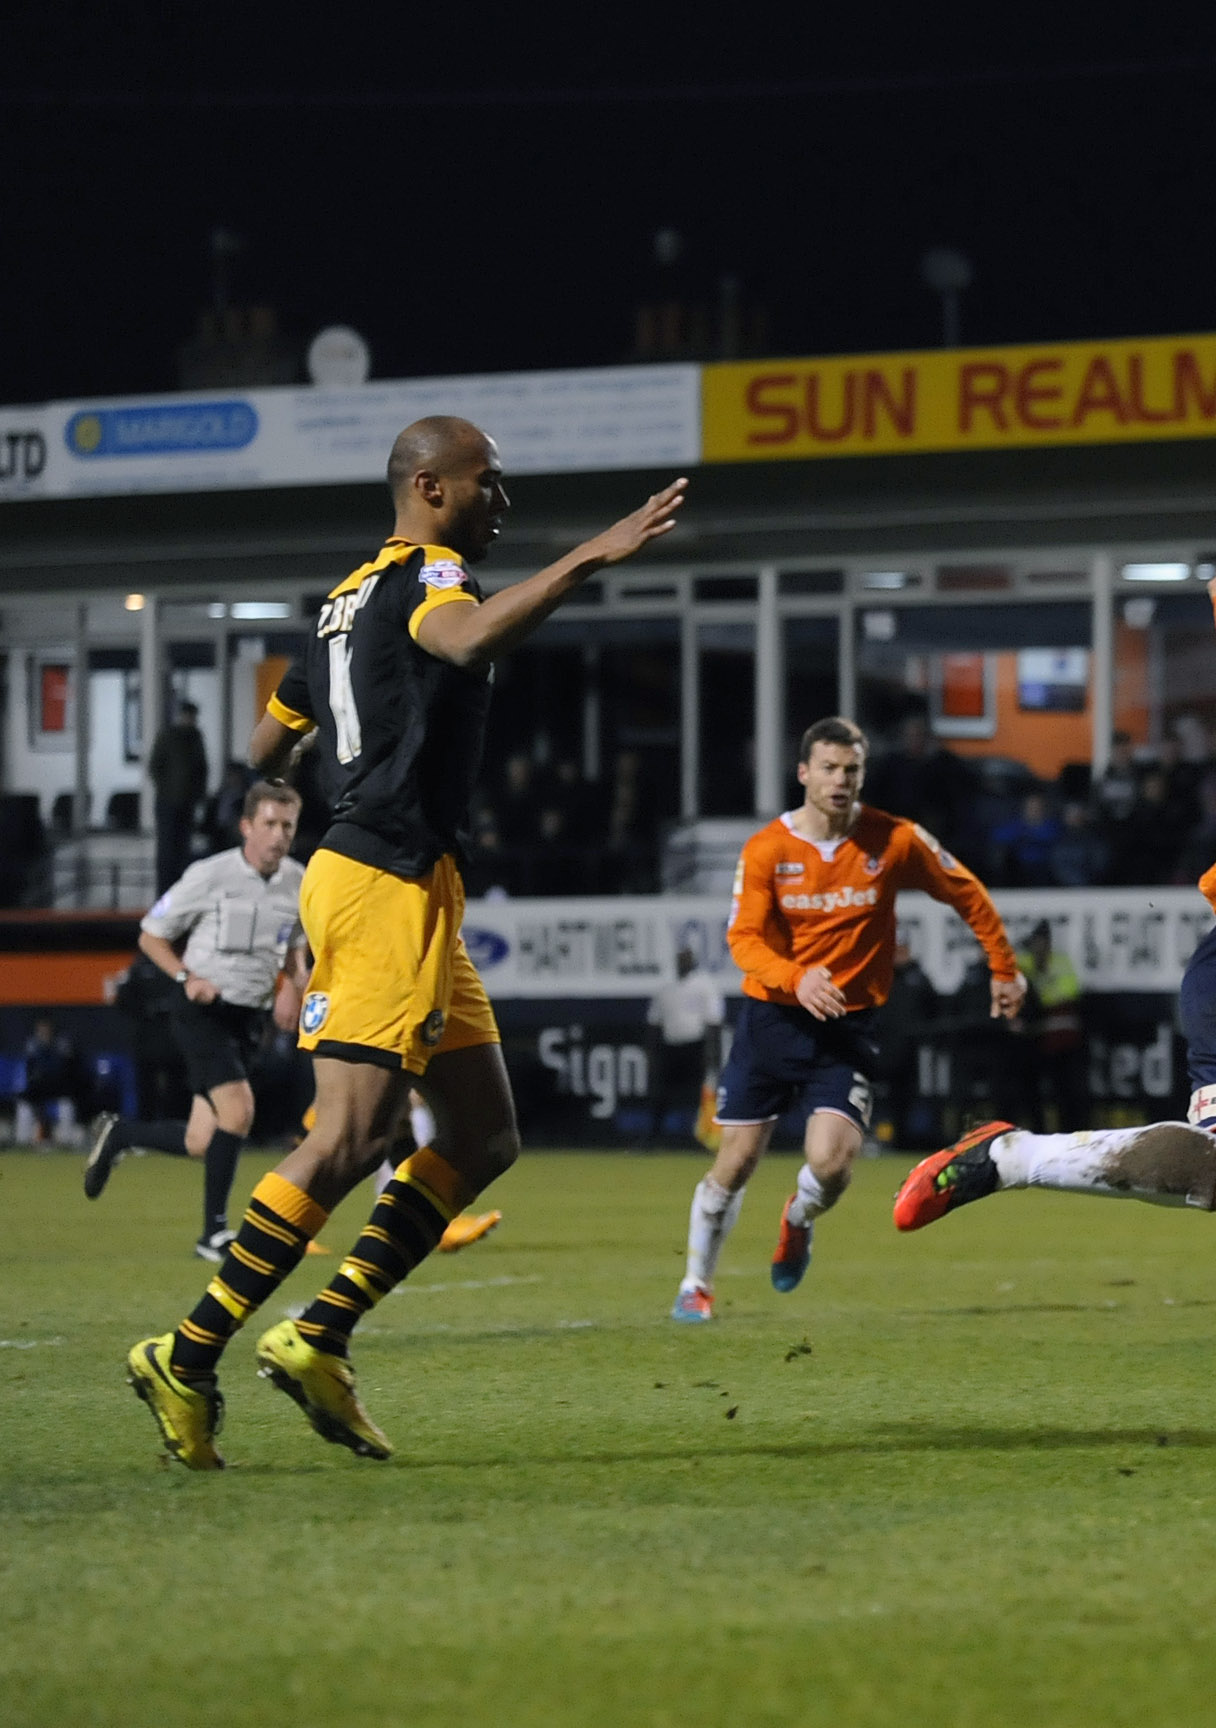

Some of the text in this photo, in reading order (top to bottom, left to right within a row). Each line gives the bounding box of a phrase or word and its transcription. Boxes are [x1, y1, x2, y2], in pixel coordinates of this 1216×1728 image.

[745, 366, 916, 446] SUN
[781, 886, 878, 913] easyJet
[540, 1024, 648, 1118] Sign
